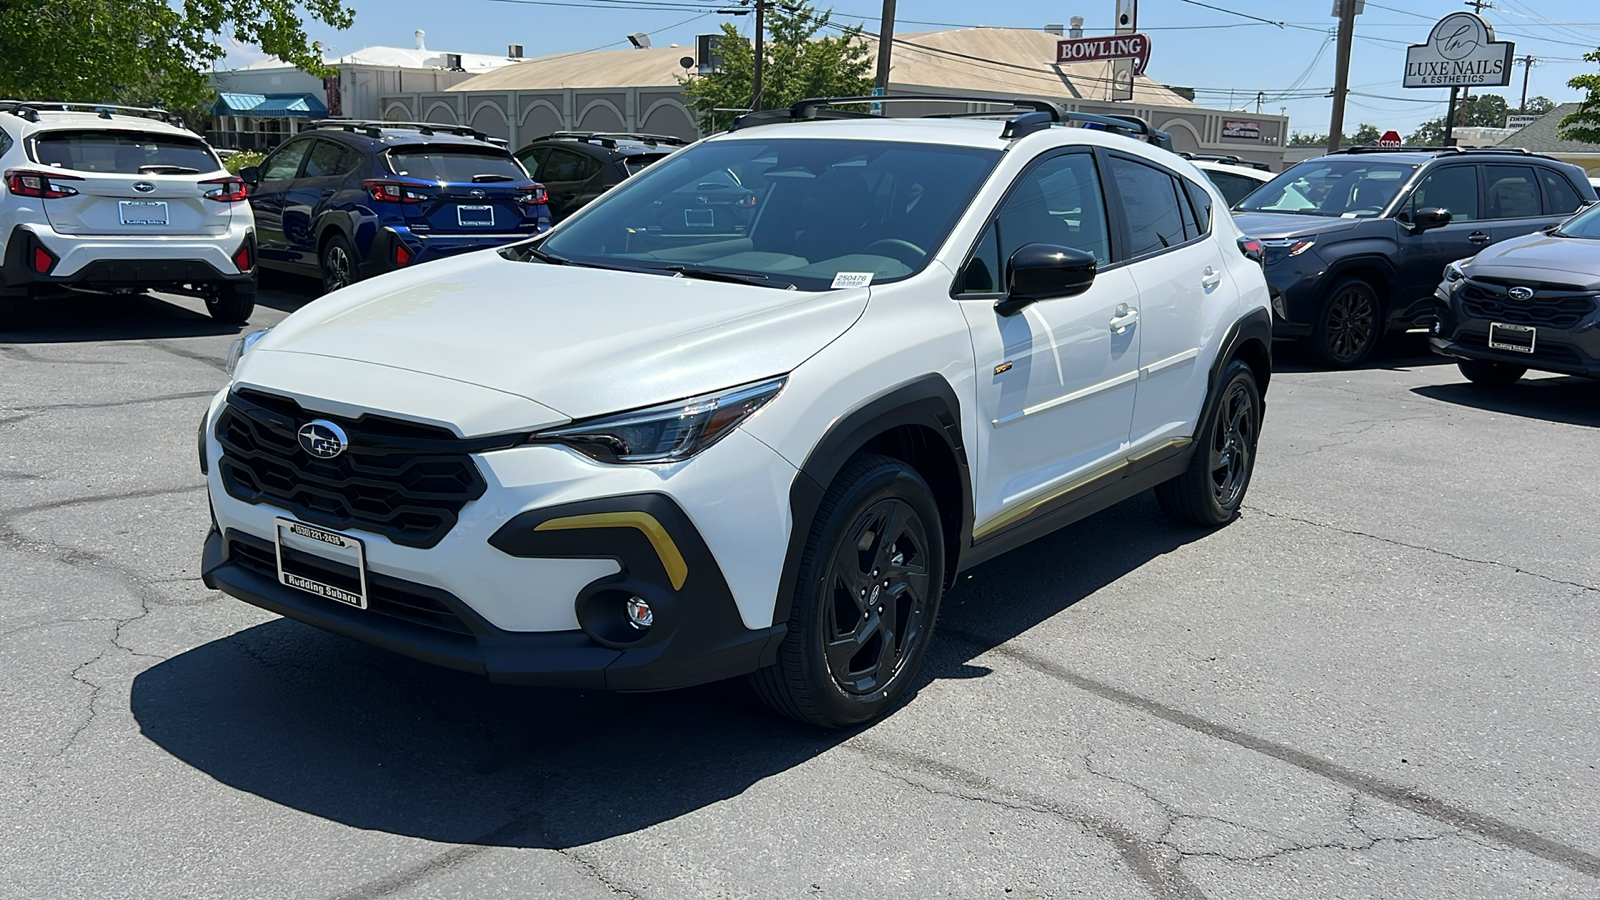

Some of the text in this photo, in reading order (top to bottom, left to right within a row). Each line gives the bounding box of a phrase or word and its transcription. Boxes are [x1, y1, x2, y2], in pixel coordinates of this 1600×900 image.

[1061, 38, 1142, 58] BOWLING
[1408, 60, 1502, 76] LUXE NAILS
[1431, 75, 1484, 83] ESTHETICS
[295, 526, 311, 536] (530)
[325, 586, 357, 604] Subaru
